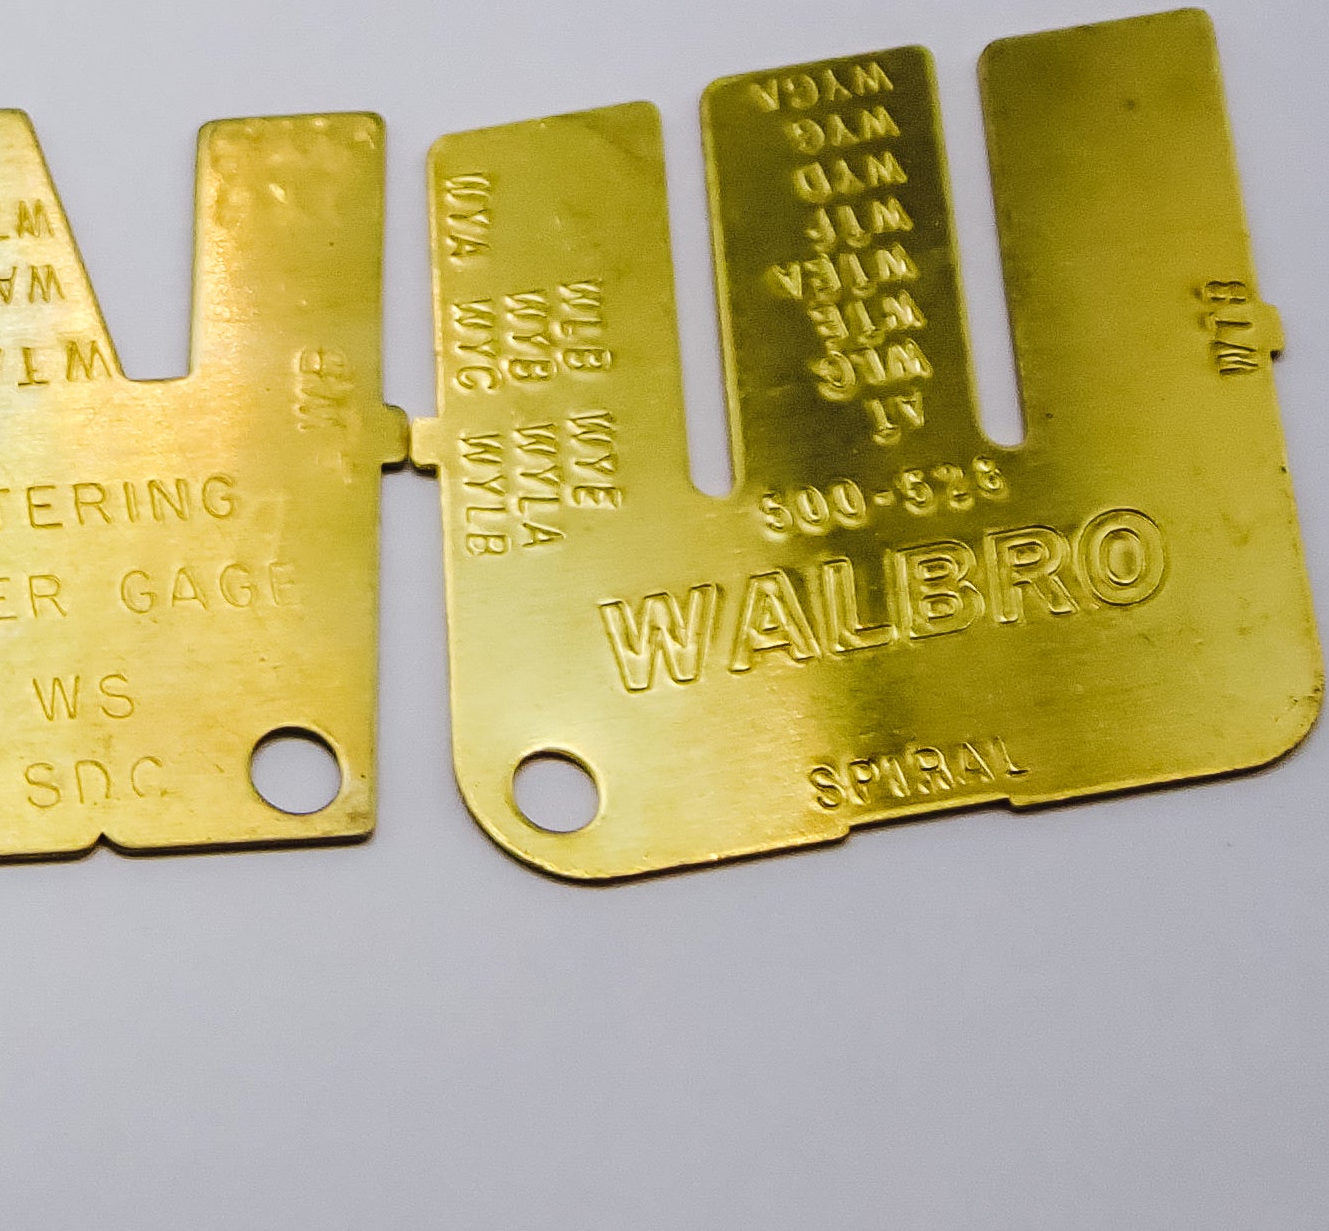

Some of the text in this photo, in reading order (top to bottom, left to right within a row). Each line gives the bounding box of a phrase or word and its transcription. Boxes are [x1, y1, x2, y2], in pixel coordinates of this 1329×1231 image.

[444, 172, 511, 557] WYA WYC WYLB
[501, 288, 567, 549] WYB WYLA
[551, 277, 624, 510] WLB WYE
[120, 562, 300, 615] GAGE
[599, 506, 1168, 695] WALBRO
[32, 673, 135, 720] WS
[24, 754, 170, 809] SDC
[808, 735, 1030, 810] SPIRAL
